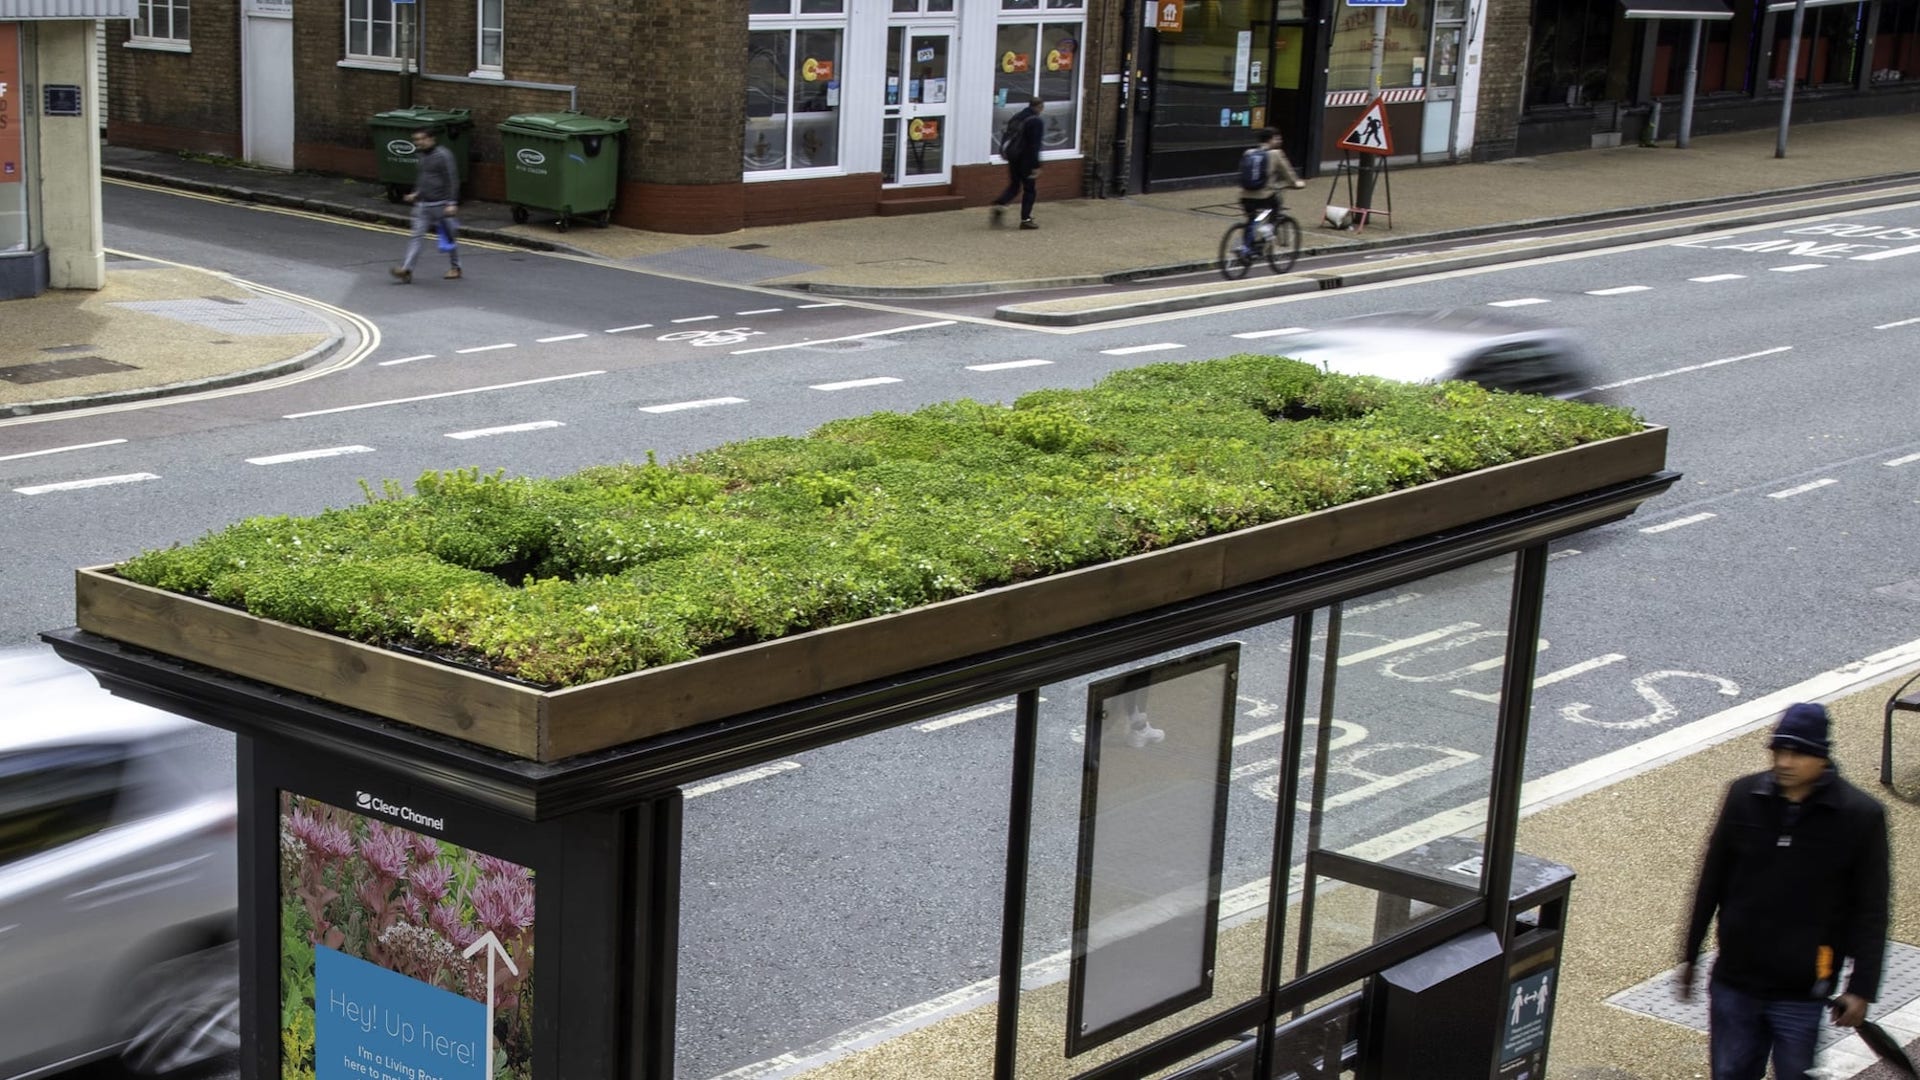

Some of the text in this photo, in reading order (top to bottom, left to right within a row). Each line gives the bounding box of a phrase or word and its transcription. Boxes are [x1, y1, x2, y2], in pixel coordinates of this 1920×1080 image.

[1671, 235, 1890, 258] LANE
[371, 797, 444, 831] Clear Channel
[330, 988, 476, 1067] Hey! Up here!
[344, 1055, 366, 1074] here
[368, 1065, 379, 1079] to
[358, 1045, 373, 1061] I'm
[375, 1054, 382, 1065] a
[385, 1056, 415, 1079] Living
[418, 1069, 444, 1080] Ro
